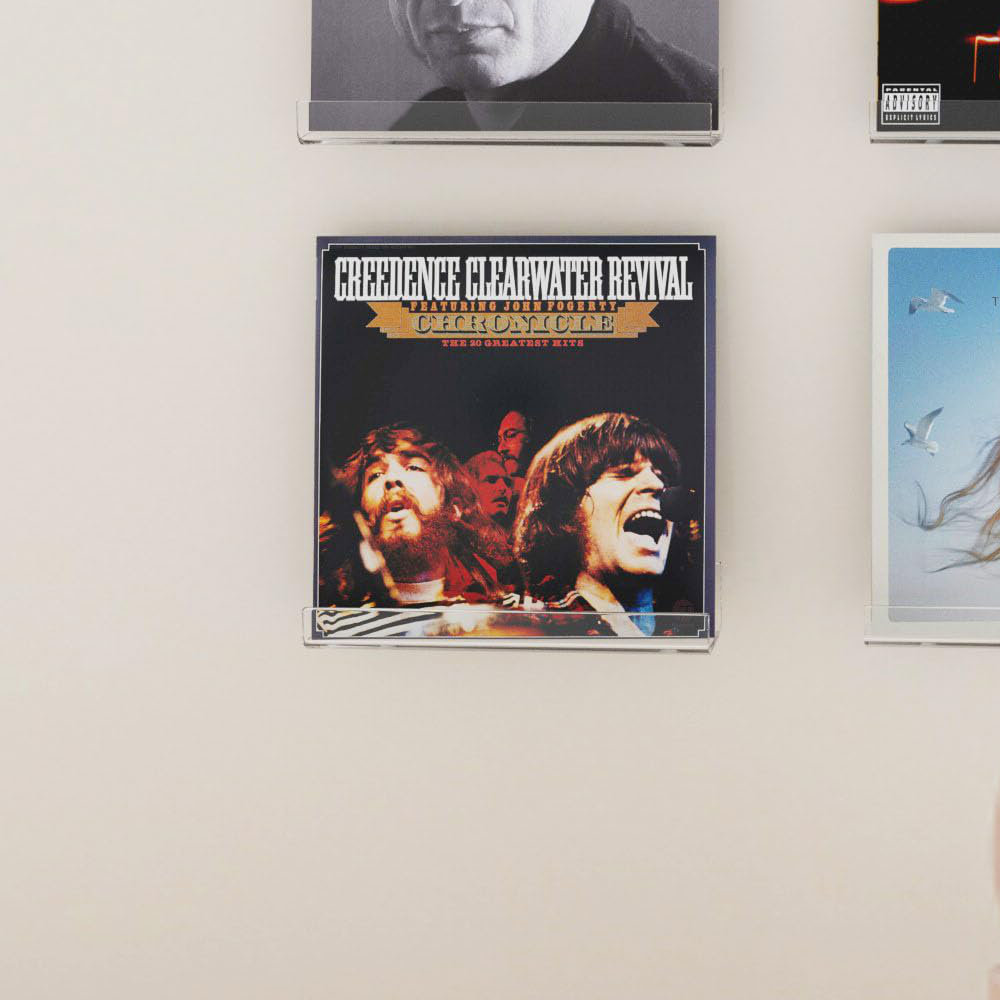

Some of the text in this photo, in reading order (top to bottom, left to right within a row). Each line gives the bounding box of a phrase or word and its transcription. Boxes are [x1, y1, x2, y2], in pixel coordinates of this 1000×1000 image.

[885, 94, 938, 111] ADVISORY
[334, 256, 694, 302] CREEDENCE CLEARWATER REVIVAL
[409, 301, 618, 311] FEATURING JOHN FOGERTY
[412, 313, 615, 335] CHRONICLE
[441, 339, 585, 348] THE 20 GREATEST HITS
